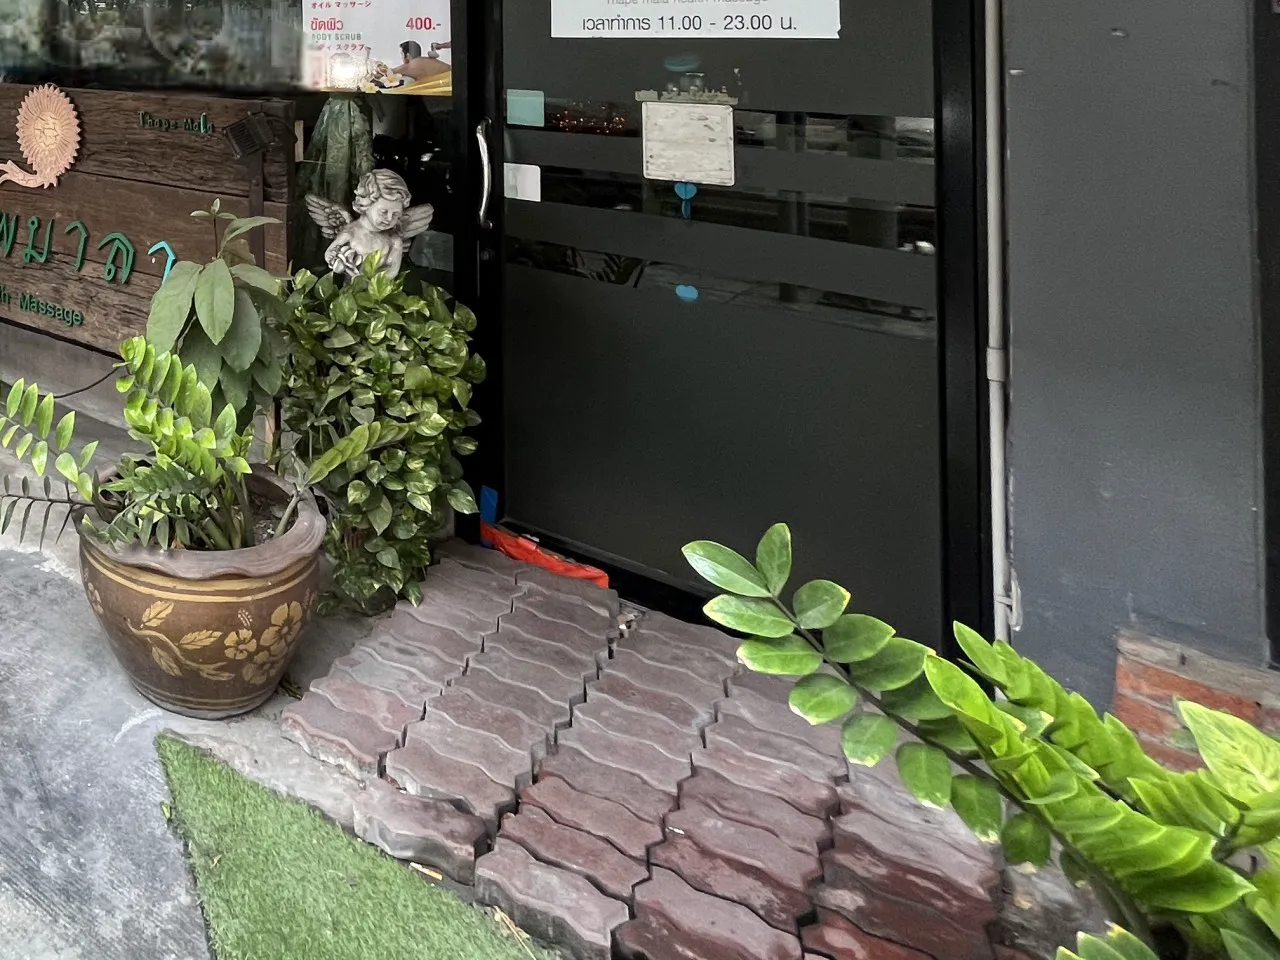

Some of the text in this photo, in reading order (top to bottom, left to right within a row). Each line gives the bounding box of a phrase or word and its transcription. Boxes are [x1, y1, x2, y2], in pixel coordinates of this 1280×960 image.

[310, 17, 441, 31] ขัดผิว 400.-
[582, 14, 651, 31] เวลาทำการ
[657, 15, 702, 31] 11.00
[723, 14, 772, 30] 23.00
[780, 16, 797, 30] น.
[334, 33, 362, 41] SCRUB
[19, 293, 85, 327] Massage
